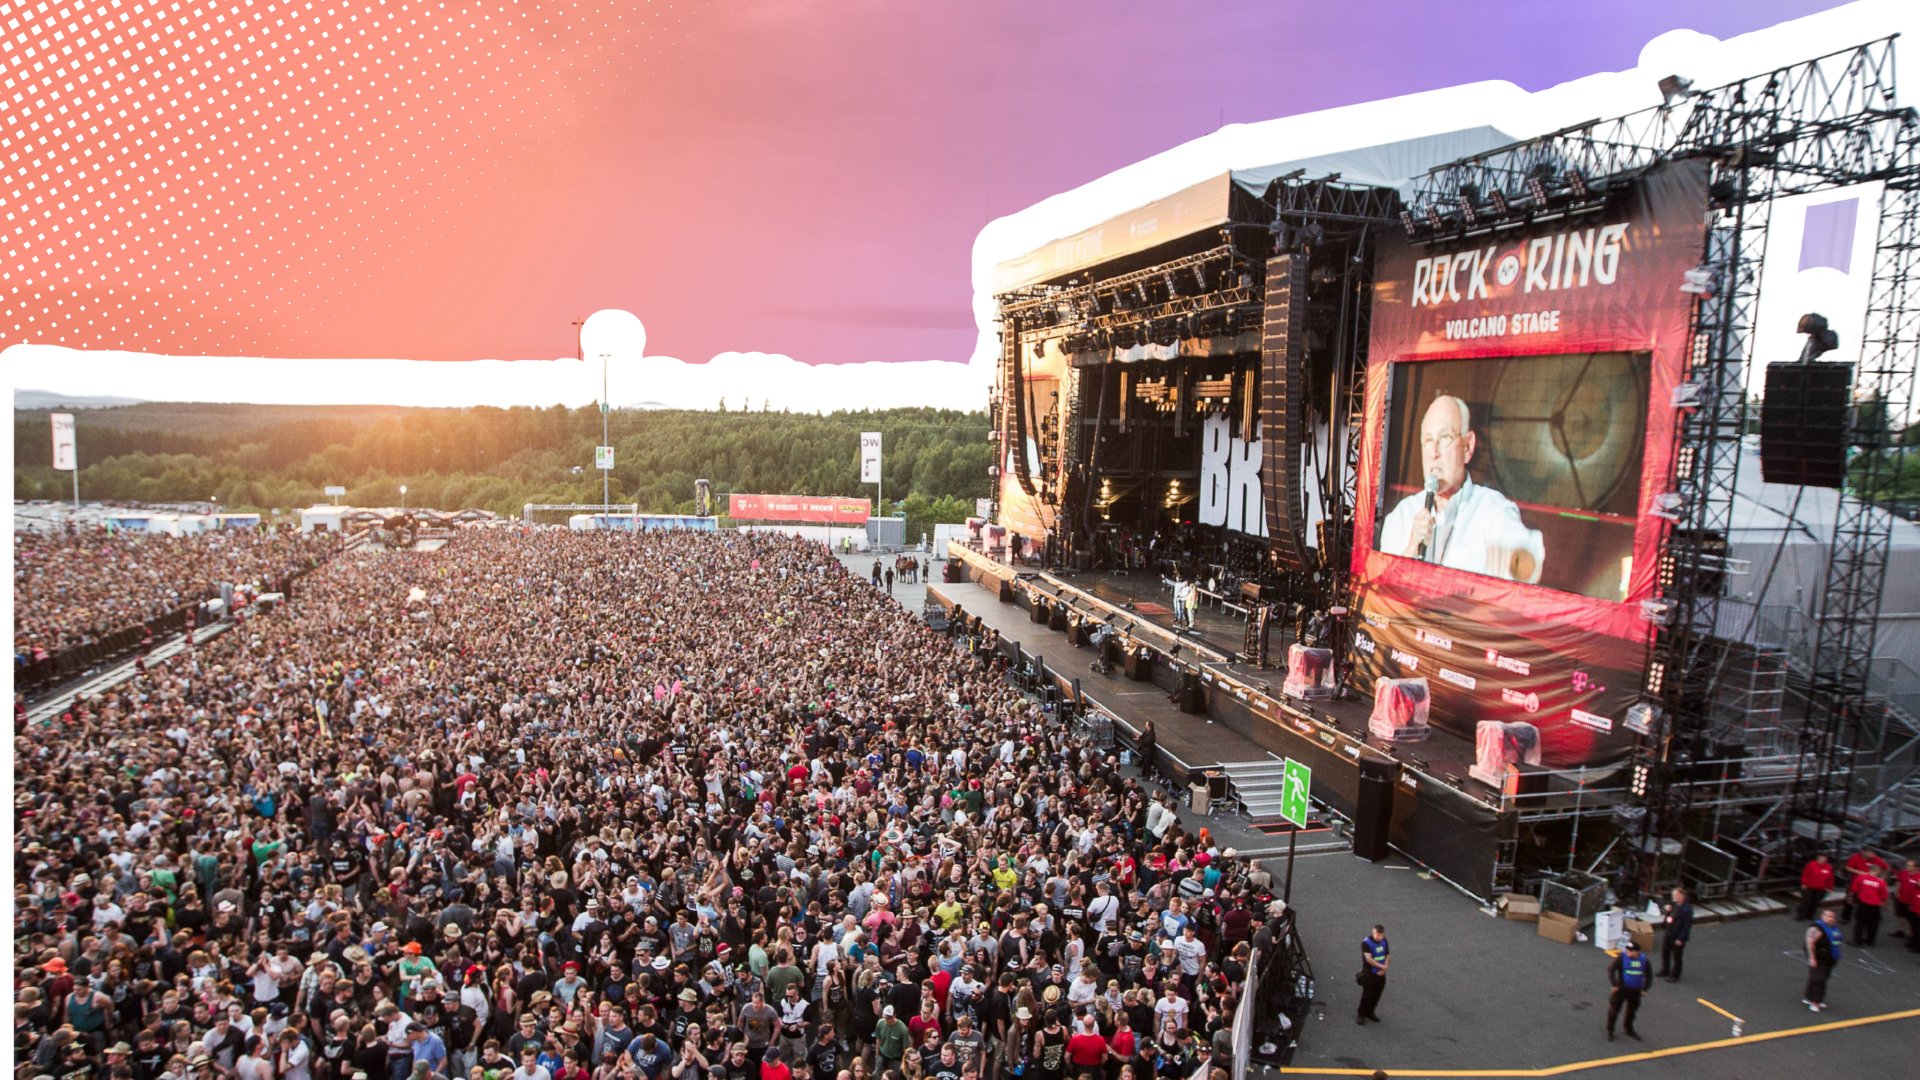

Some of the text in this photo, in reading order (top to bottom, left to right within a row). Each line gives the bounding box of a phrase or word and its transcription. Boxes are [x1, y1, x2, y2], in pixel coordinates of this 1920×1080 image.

[1411, 246, 1497, 308] ROCK
[1524, 222, 1630, 294] RING
[1446, 310, 1560, 340] VOLCANO STAGE
